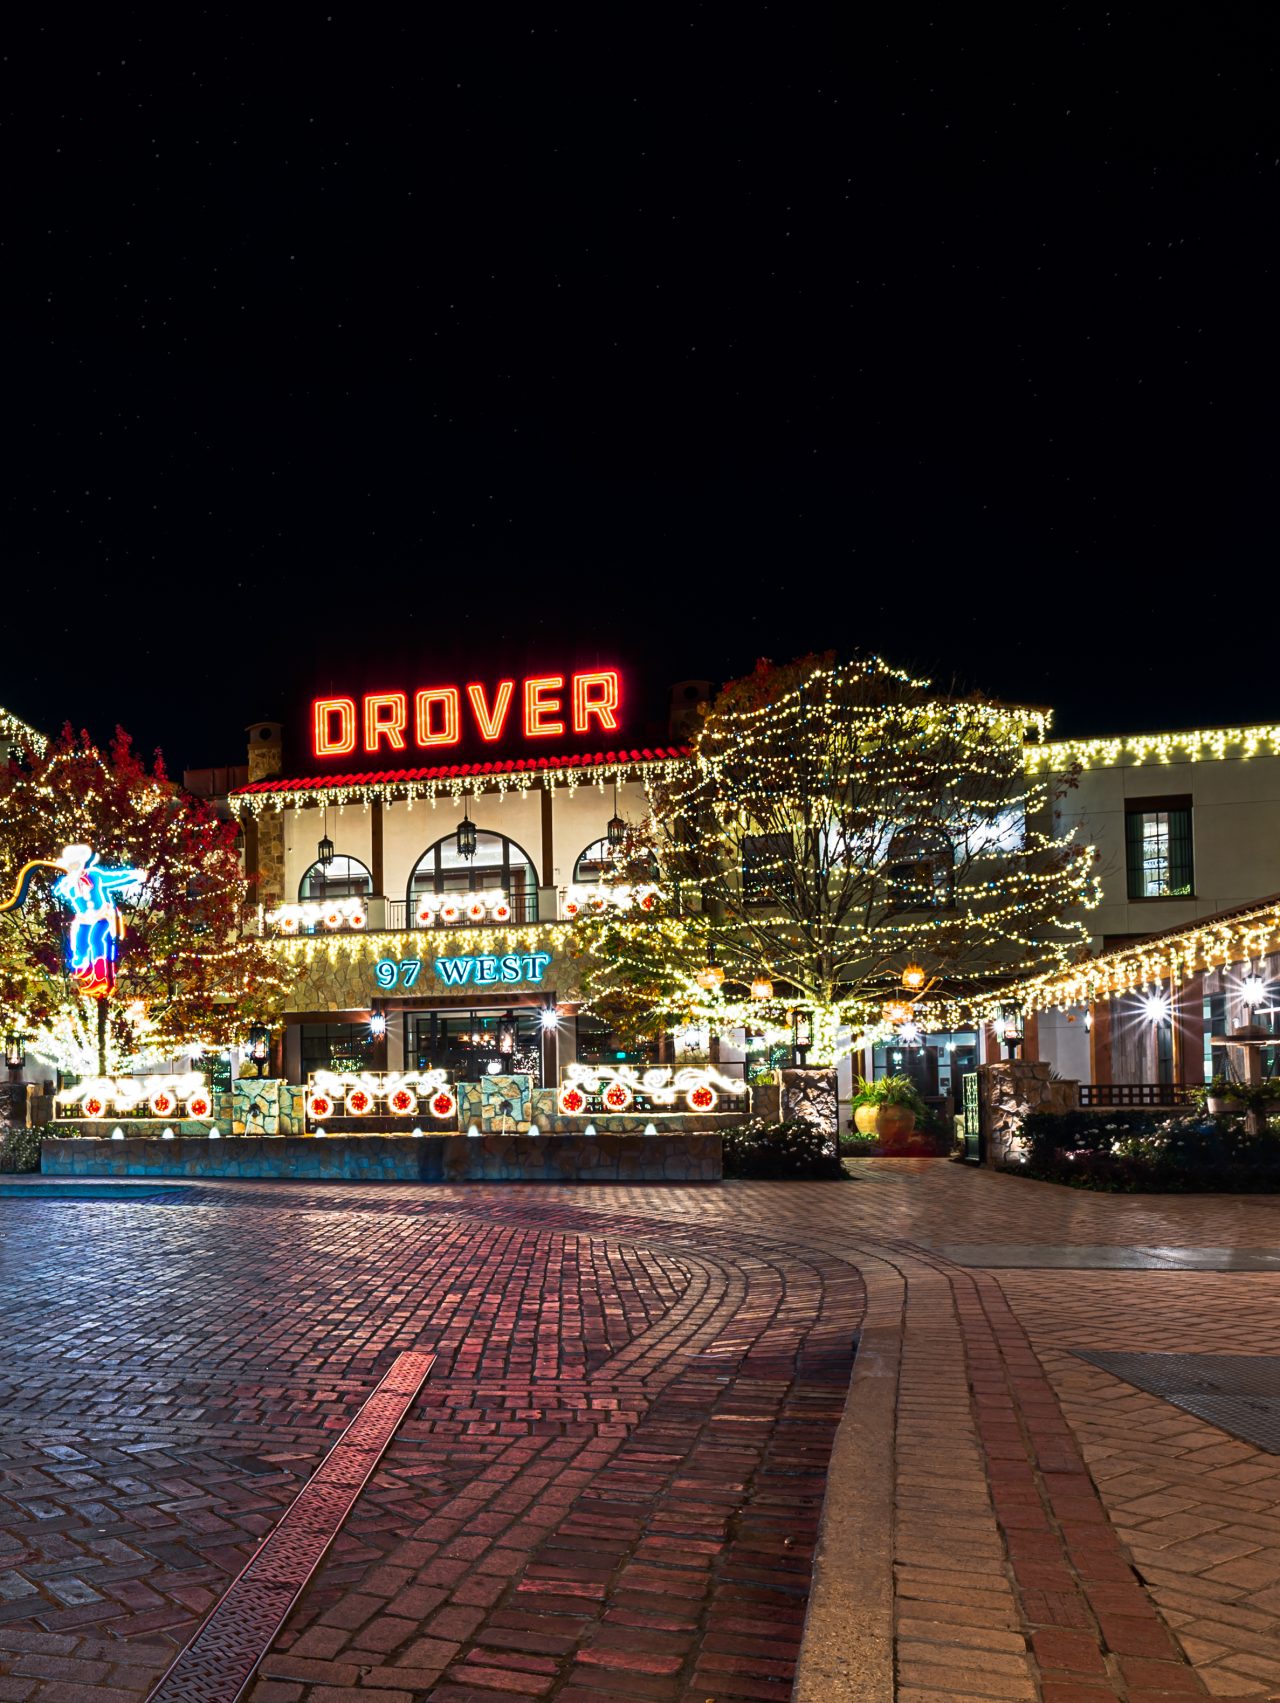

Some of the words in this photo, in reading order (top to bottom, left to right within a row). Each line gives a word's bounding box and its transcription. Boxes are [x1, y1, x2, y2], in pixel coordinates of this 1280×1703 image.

[313, 670, 620, 757] DROVER
[376, 960, 420, 988] 97
[435, 954, 549, 985] WEST
